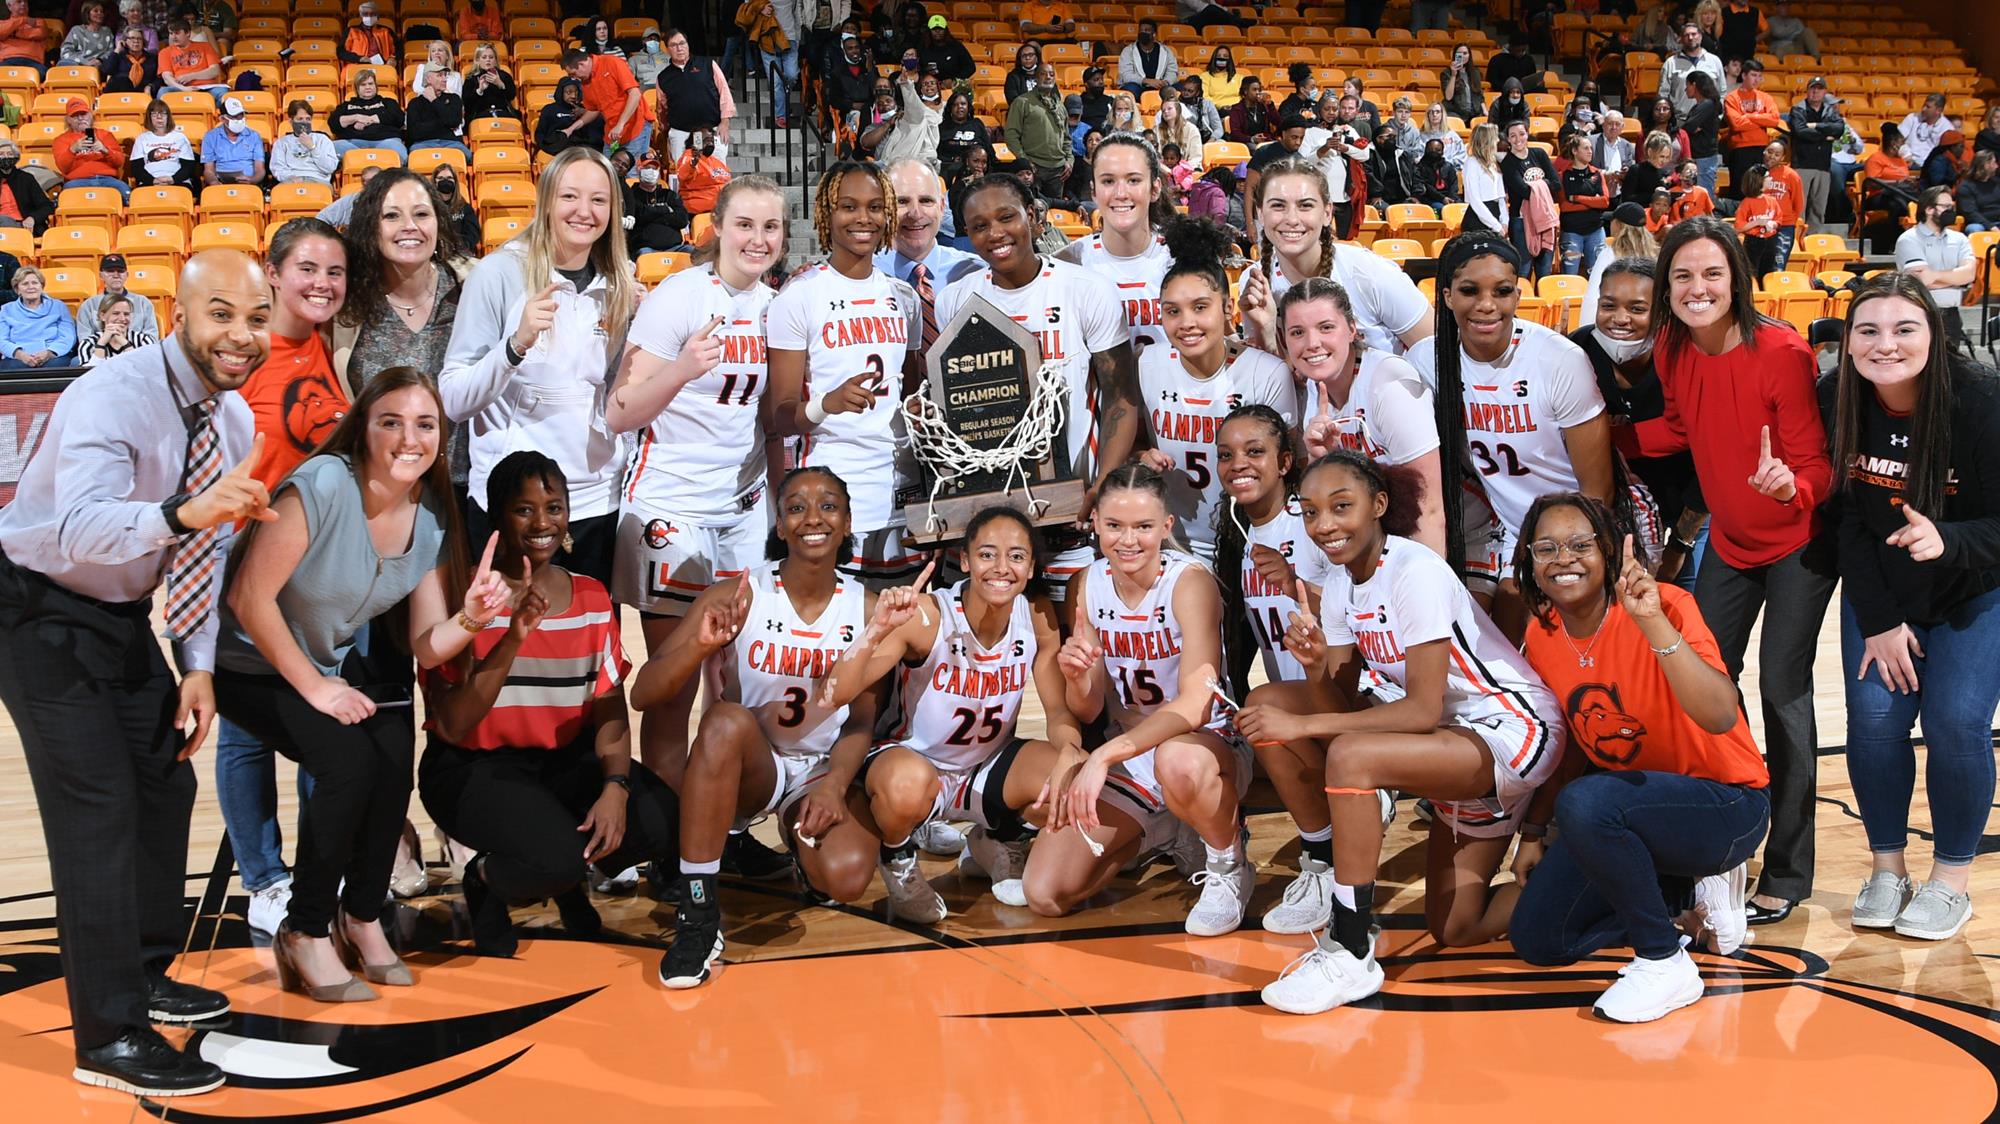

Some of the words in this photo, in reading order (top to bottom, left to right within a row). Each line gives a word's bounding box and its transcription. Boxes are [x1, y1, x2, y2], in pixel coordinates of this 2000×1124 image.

[822, 316, 908, 349] CAMPBELL
[948, 349, 1014, 374] SOUTH
[716, 373, 759, 406] 11
[950, 384, 1020, 405] CHAMPION
[960, 420, 990, 431] REGULAR
[990, 415, 1016, 427] SEASON
[1460, 402, 1537, 434] AMPBELL
[960, 431, 983, 441] OMEN'S
[1185, 451, 1211, 489] 5
[1470, 440, 1530, 477] 32
[1250, 606, 1289, 652] 14
[933, 662, 1027, 700] CAMPBELL
[1116, 665, 1165, 706] 15
[777, 686, 808, 729] 3
[945, 703, 1004, 746] 25
